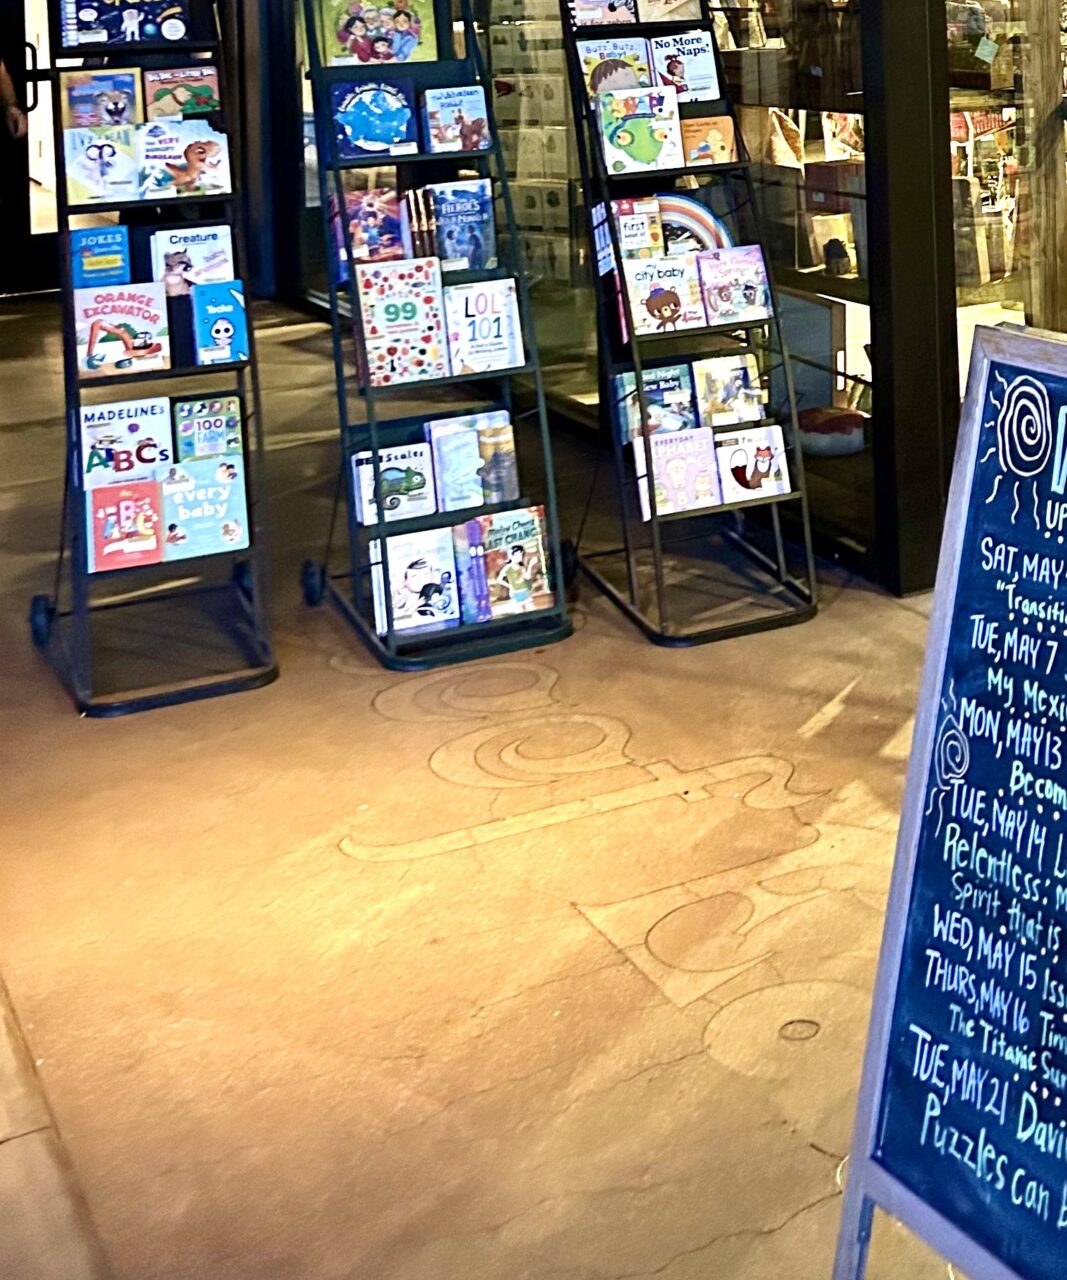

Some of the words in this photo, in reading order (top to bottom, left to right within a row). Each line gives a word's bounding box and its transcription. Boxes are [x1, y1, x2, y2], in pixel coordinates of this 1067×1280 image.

[655, 40, 671, 50] No
[673, 37, 703, 47] More
[676, 43, 711, 58] Naps!
[169, 232, 219, 245] Creature
[623, 221, 646, 233] first
[80, 233, 123, 246] JOKES
[634, 271, 655, 282] city
[657, 266, 685, 279] baby
[94, 292, 155, 307] ORANGE
[465, 292, 502, 318] LOL
[83, 305, 161, 324] EXCAVATOR
[384, 302, 418, 323] 99
[467, 317, 503, 343] 101
[660, 378, 681, 392] Baby
[196, 418, 224, 431] 100
[173, 485, 232, 505] every
[178, 501, 229, 521] baby
[1022, 553, 1062, 590] MAY
[1003, 628, 1041, 670] MAY
[1038, 640, 1059, 675] 7
[987, 666, 1014, 709] My
[1006, 719, 1047, 767] MAY
[1044, 731, 1063, 770] 13
[992, 798, 1029, 854] MAY
[1027, 819, 1047, 873] 14
[951, 870, 1002, 919] Spirit
[1006, 896, 1044, 946] that
[1048, 920, 1063, 952] is
[976, 924, 1018, 979] MAY
[1017, 951, 1038, 991] 15
[980, 977, 1015, 1025] MAY
[1011, 997, 1031, 1035] 16
[948, 1002, 976, 1039] The
[978, 1019, 1039, 1073] Titanic
[950, 1058, 990, 1112] MAY
[984, 1075, 1010, 1126] 21
[919, 1090, 1009, 1191] Puzzles
